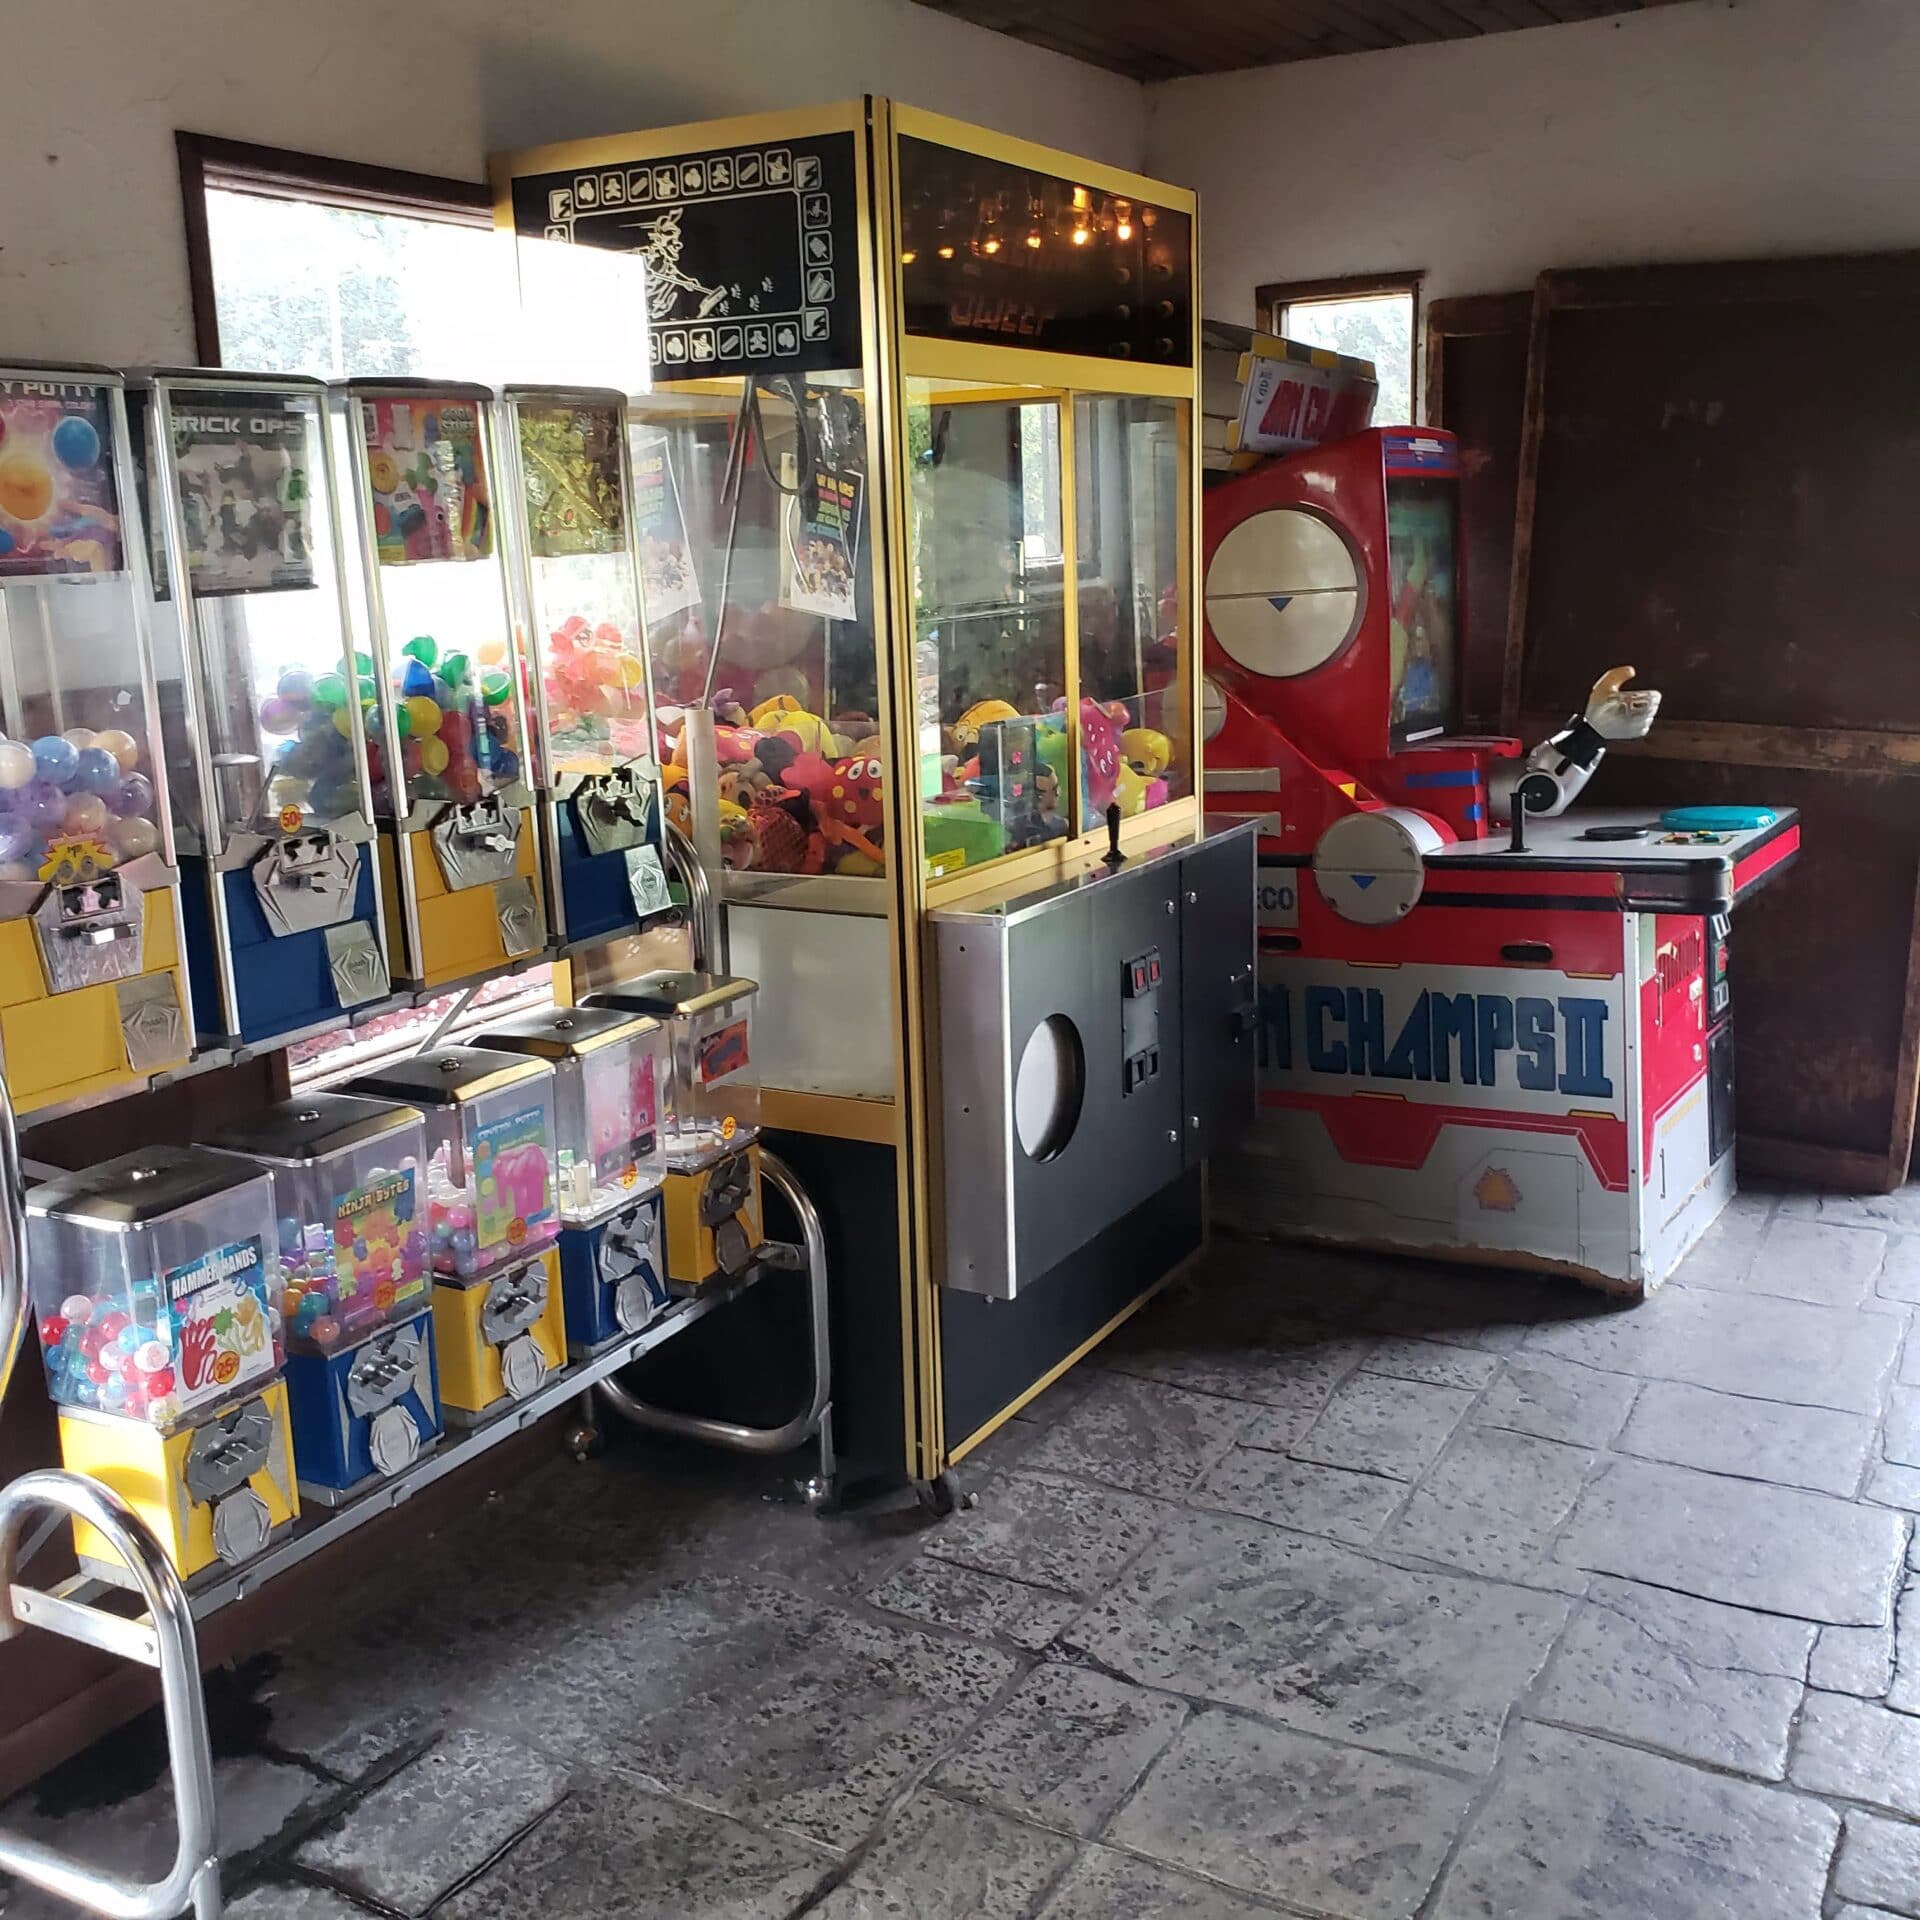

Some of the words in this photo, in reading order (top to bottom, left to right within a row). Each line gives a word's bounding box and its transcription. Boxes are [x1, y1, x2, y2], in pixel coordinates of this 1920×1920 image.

[22, 382, 97, 398] PUTTY
[171, 416, 241, 433] BRICK
[250, 418, 301, 434] OPS
[337, 1192, 373, 1218] NINJA
[171, 1263, 218, 1300] HAMMER
[221, 1246, 258, 1279] HANDS
